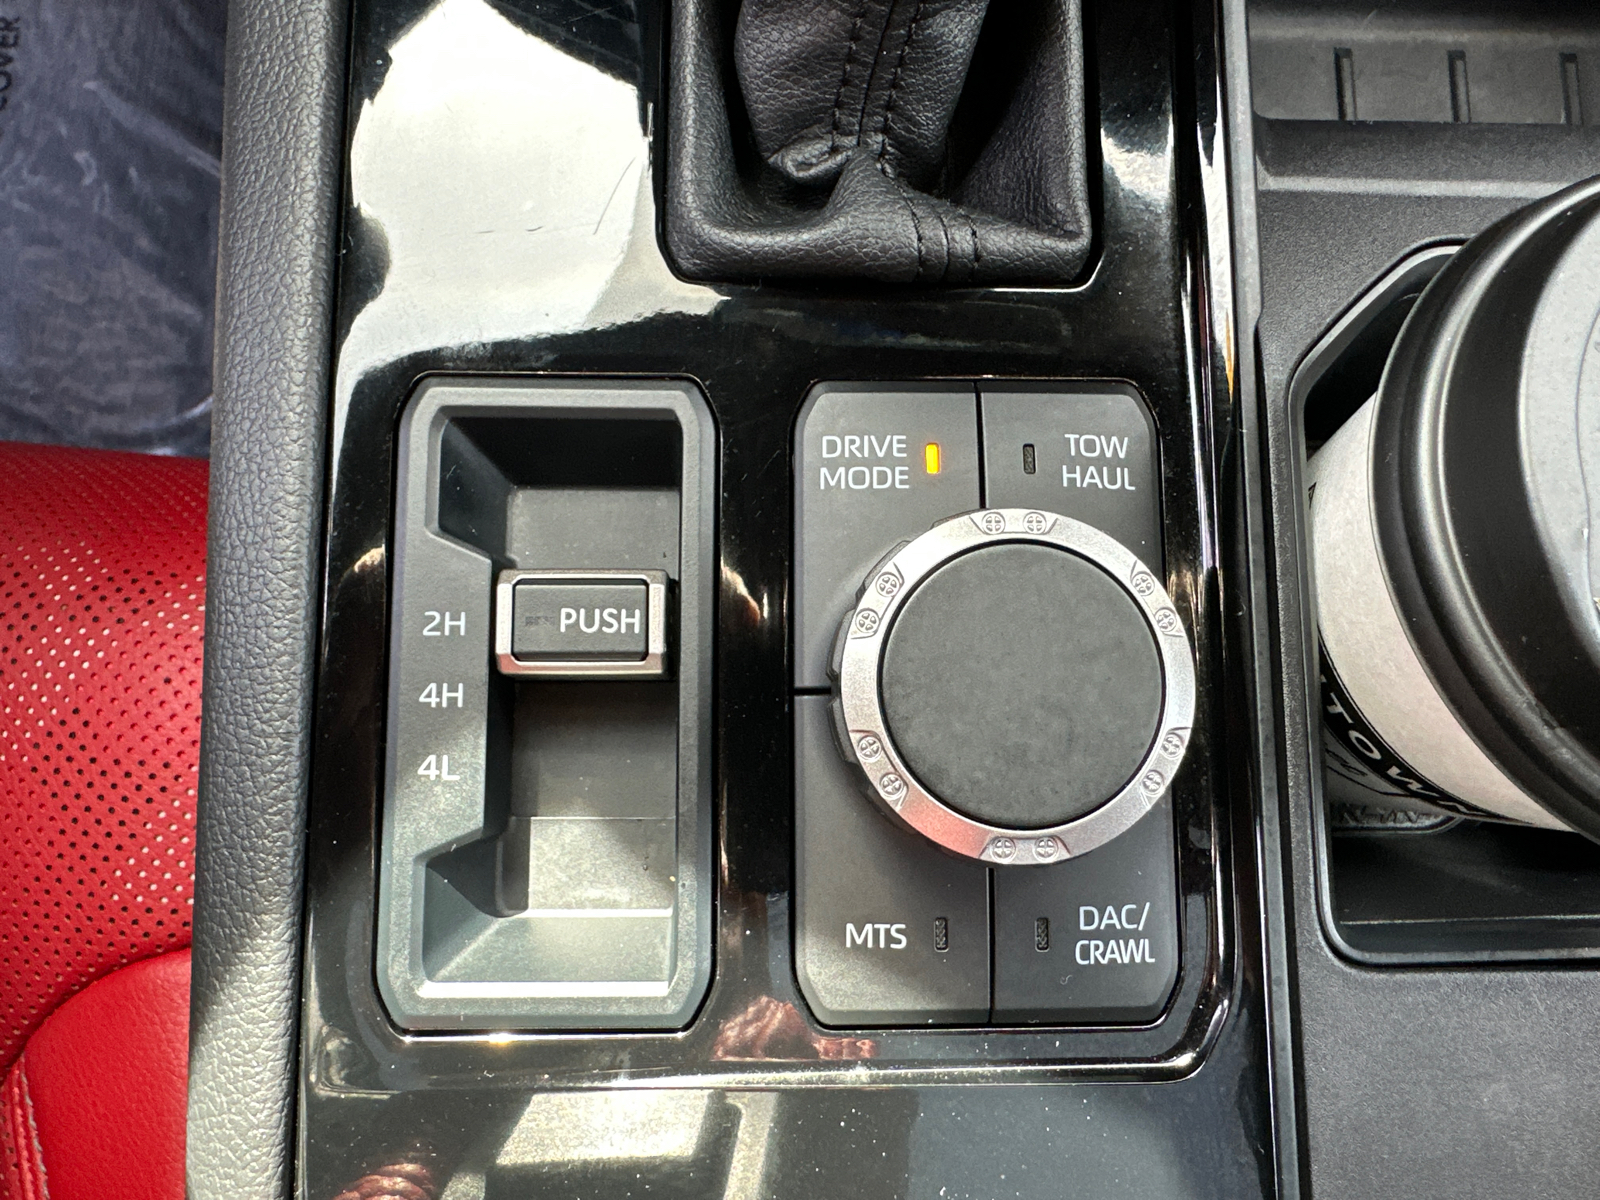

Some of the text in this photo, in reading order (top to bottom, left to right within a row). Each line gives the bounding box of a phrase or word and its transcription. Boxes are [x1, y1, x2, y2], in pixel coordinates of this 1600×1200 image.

[821, 435, 908, 459] DRIVE
[1064, 433, 1129, 459] TOW
[819, 466, 910, 491] MODE
[1062, 465, 1136, 491] HAUL
[422, 611, 466, 636] 2H
[559, 607, 641, 634] PUSH
[418, 682, 464, 708] 4H
[416, 754, 461, 781] 4L
[1078, 901, 1151, 931] DAC/
[845, 922, 908, 950] MTS
[1075, 938, 1156, 966] CRAWL
